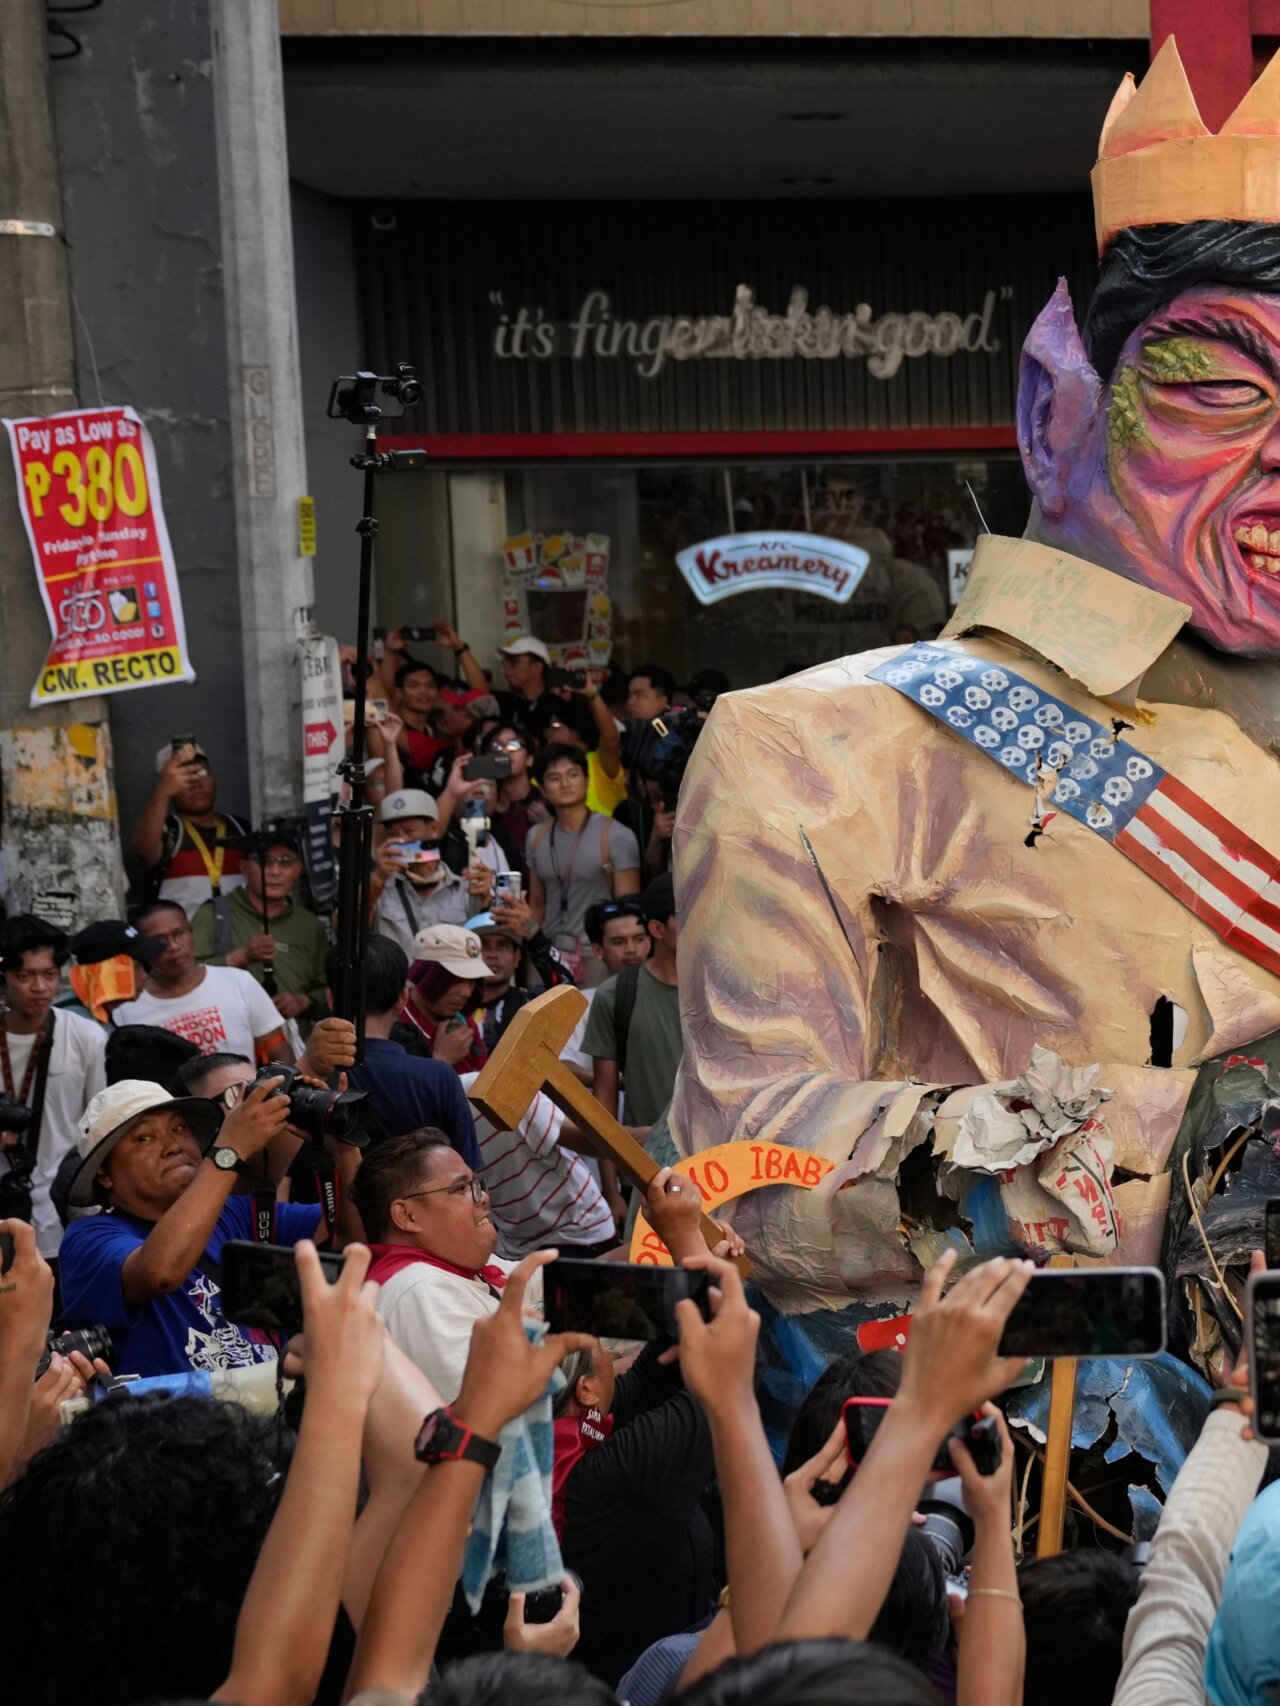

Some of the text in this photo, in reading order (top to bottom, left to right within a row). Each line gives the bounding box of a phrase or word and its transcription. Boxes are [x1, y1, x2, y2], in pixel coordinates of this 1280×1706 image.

[17, 418, 137, 454] Pay as Low as
[759, 540, 790, 551] KFC
[695, 548, 852, 593] Kreamery
[93, 651, 176, 686] RECTO
[306, 730, 329, 749] THIS
[324, 1181, 335, 1223] Canon
[258, 1210, 270, 1239] EOS
